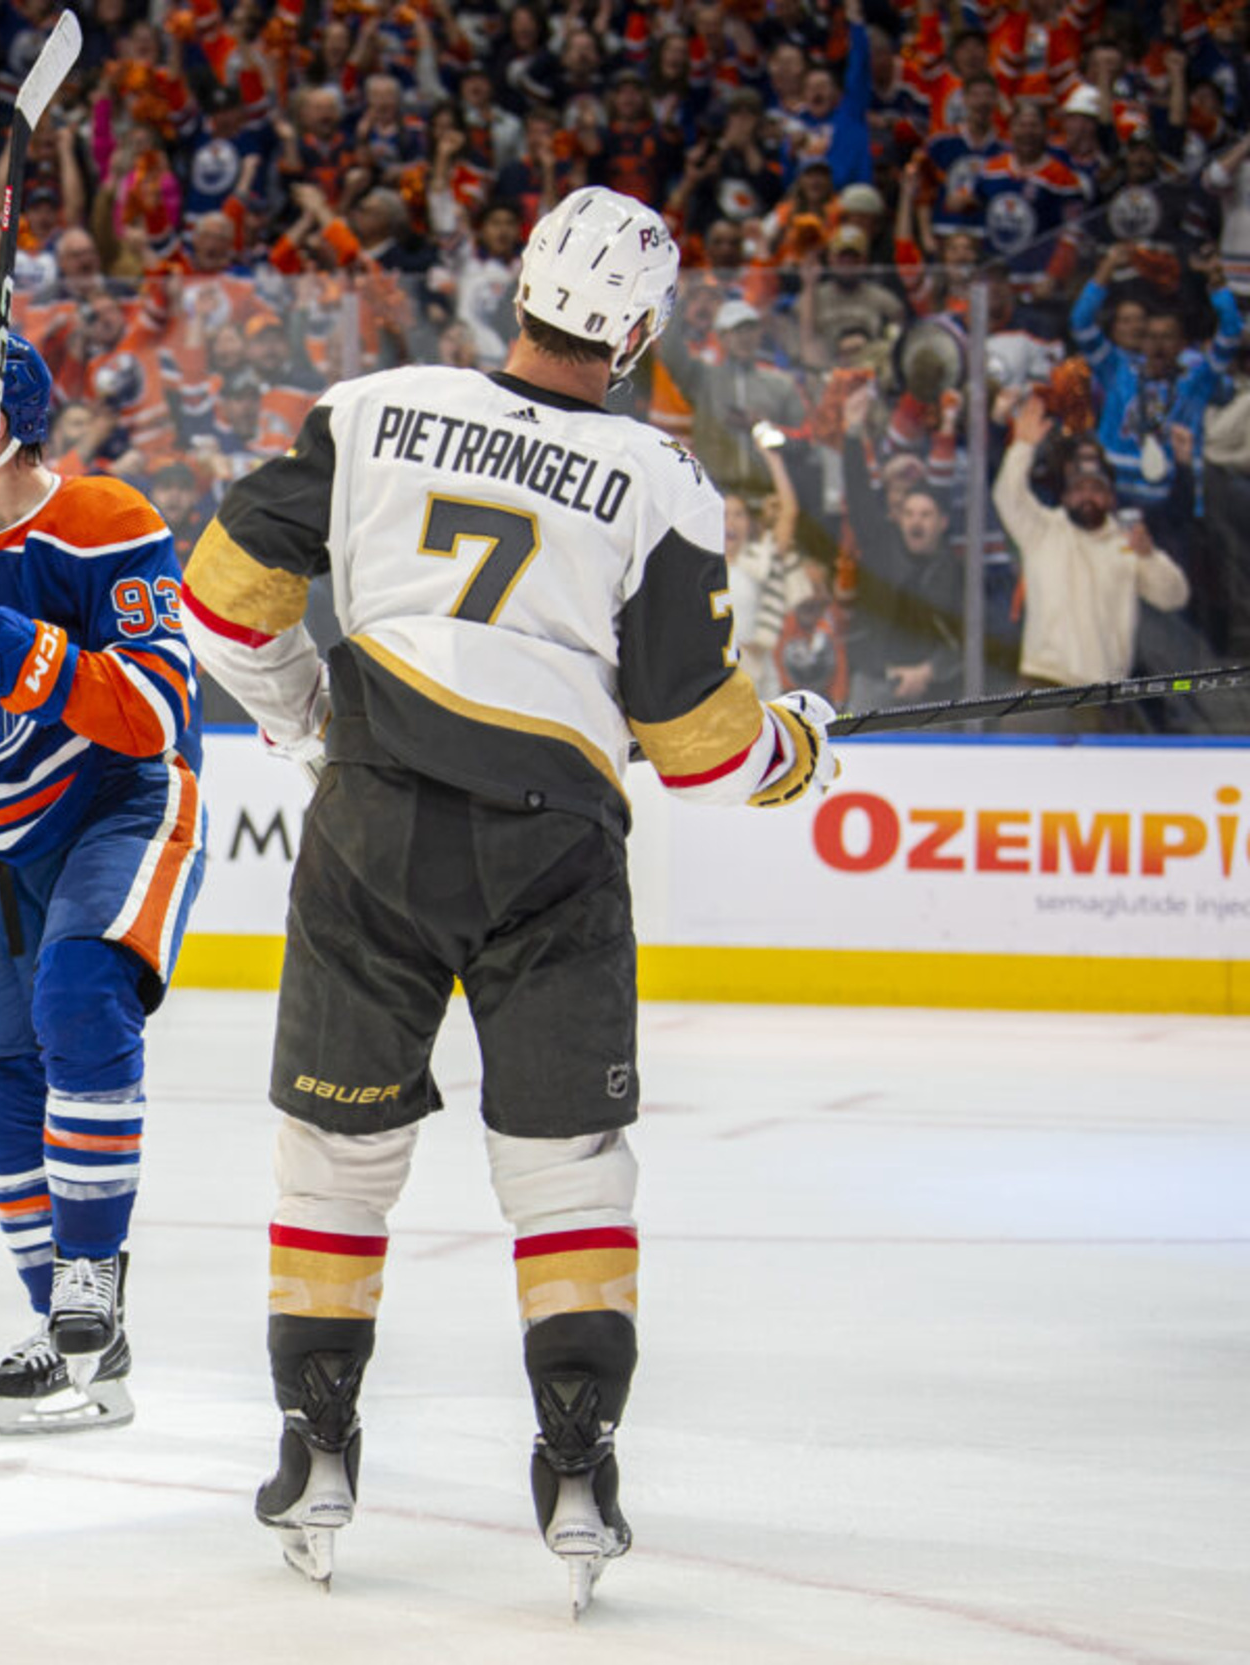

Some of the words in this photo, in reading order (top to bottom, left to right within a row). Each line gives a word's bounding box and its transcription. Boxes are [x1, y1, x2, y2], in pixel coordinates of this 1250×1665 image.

[556, 287, 569, 311] 7
[373, 405, 632, 524] PIETRANGELO
[417, 491, 541, 626] 7
[110, 576, 183, 638] 93
[812, 785, 1250, 879] OZEMPi
